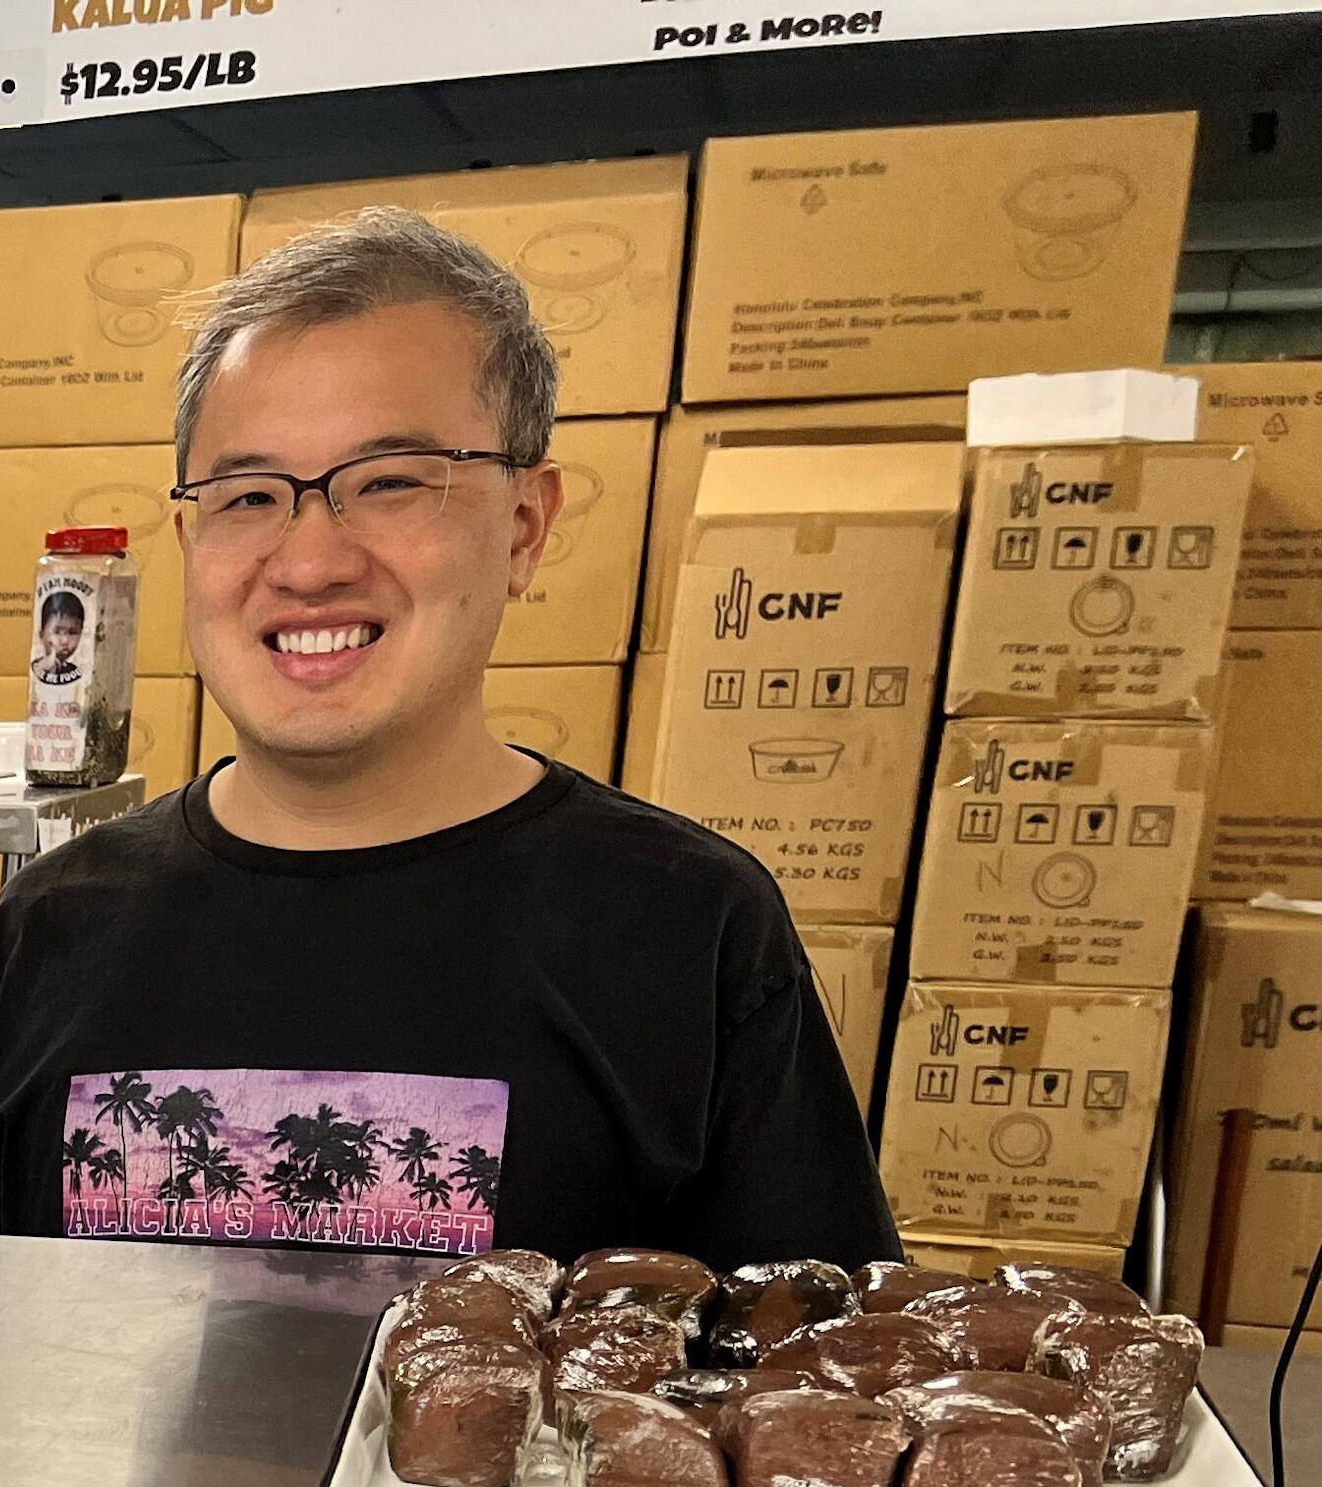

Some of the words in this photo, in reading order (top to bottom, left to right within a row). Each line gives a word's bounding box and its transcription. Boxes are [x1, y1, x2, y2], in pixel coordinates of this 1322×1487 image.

[654, 24, 717, 50] POI
[725, 23, 751, 44] &
[61, 50, 256, 105] $12.95/LB
[1045, 482, 1114, 505] CNF
[757, 591, 844, 622] CNF
[1008, 759, 1076, 783] CNF
[827, 842, 866, 858] KGS
[823, 866, 862, 882] KGS
[963, 1023, 1029, 1047] CNF
[68, 1197, 254, 1240] ALICIA'S
[271, 1201, 489, 1256] MARKET
